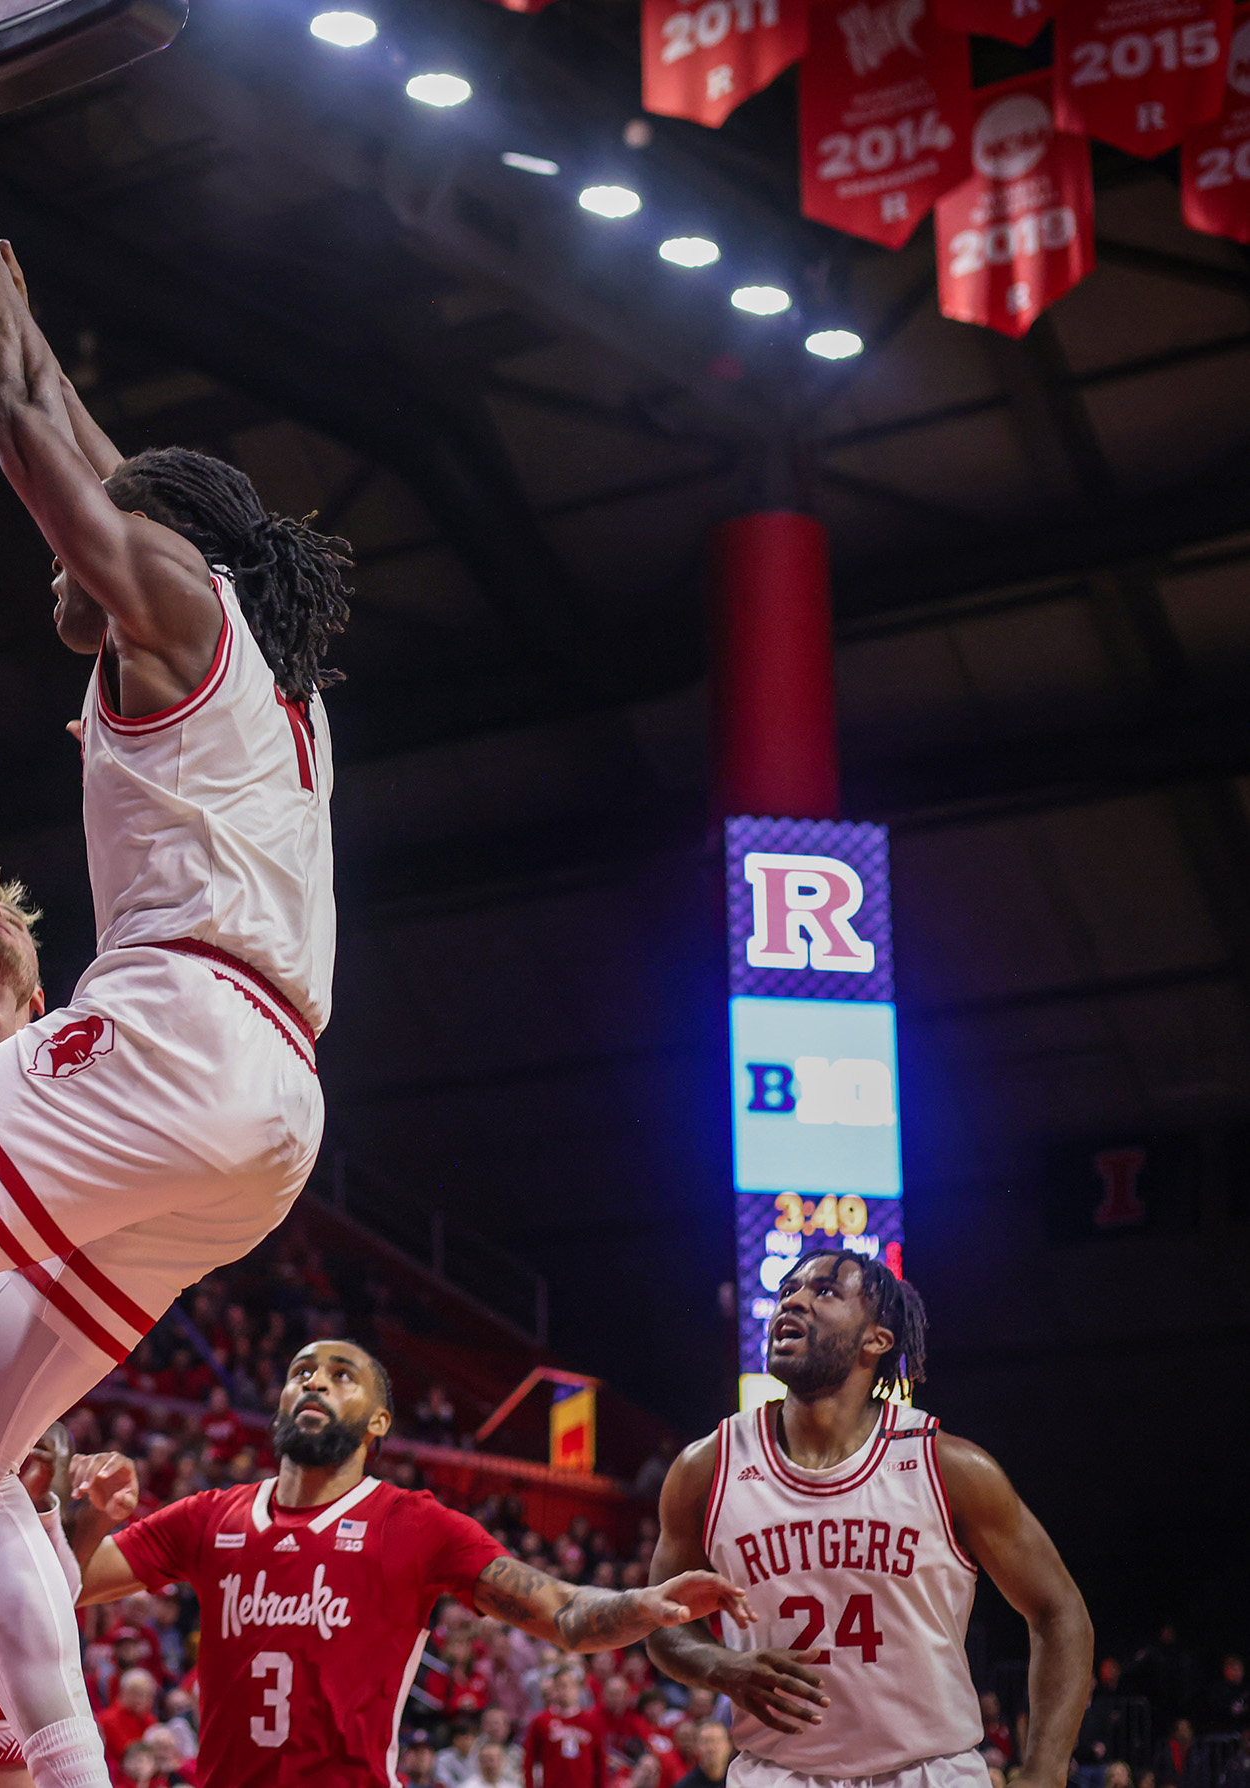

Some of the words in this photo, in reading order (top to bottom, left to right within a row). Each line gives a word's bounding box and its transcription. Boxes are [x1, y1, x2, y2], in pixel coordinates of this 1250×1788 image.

[1071, 20, 1221, 87] 2015
[817, 109, 954, 180] 2014
[1135, 101, 1166, 132] R
[744, 852, 875, 973] R
[735, 1518, 921, 1586] RUTGERS
[219, 1563, 352, 1640] Nebraska
[779, 1594, 884, 1665] 24
[250, 1652, 293, 1747] 3
